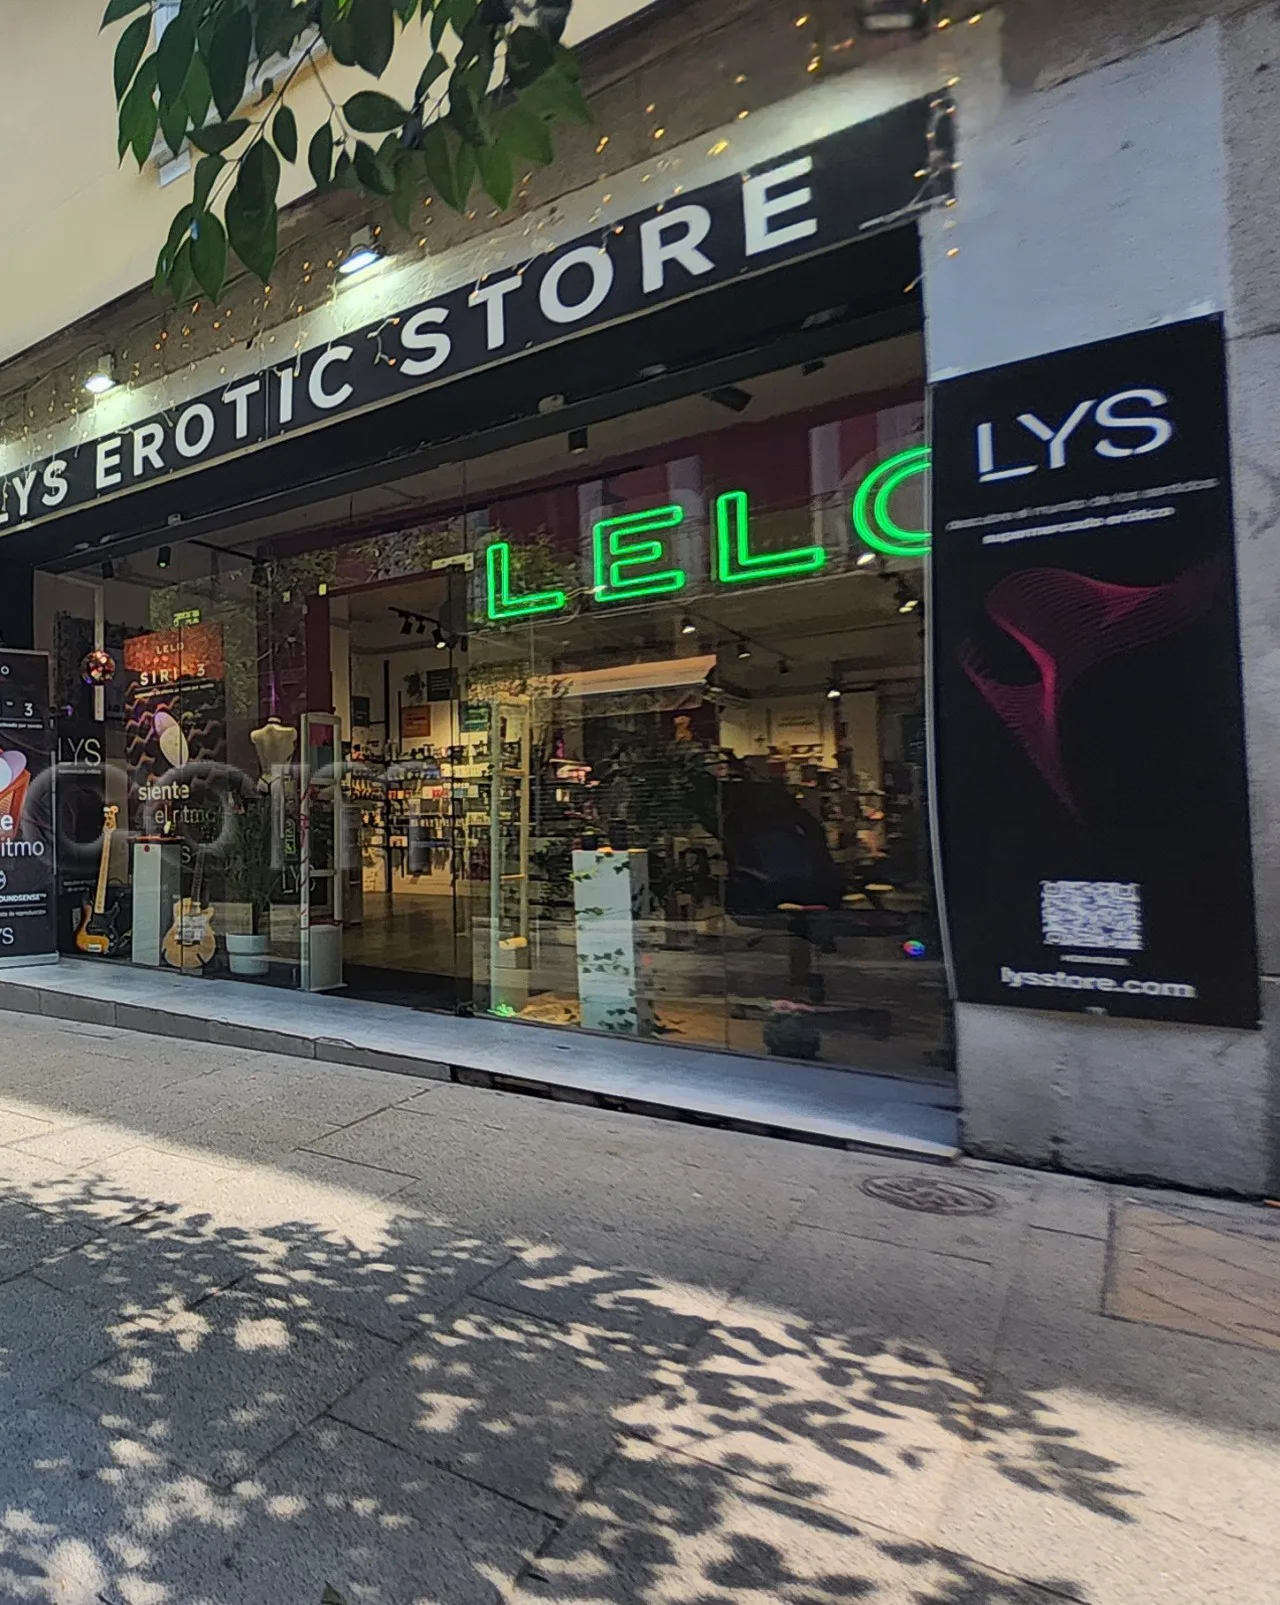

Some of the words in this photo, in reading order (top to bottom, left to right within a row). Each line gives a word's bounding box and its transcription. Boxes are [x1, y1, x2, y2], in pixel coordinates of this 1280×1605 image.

[94, 345, 355, 489] EROTIC
[397, 153, 820, 379] STORE
[976, 387, 1175, 484] LYS
[196, 663, 207, 677] 3
[24, 702, 34, 717] 3
[57, 736, 102, 767] LYS
[138, 780, 190, 801] siente
[155, 803, 169, 824] el
[999, 965, 1199, 999] lysstore.com
